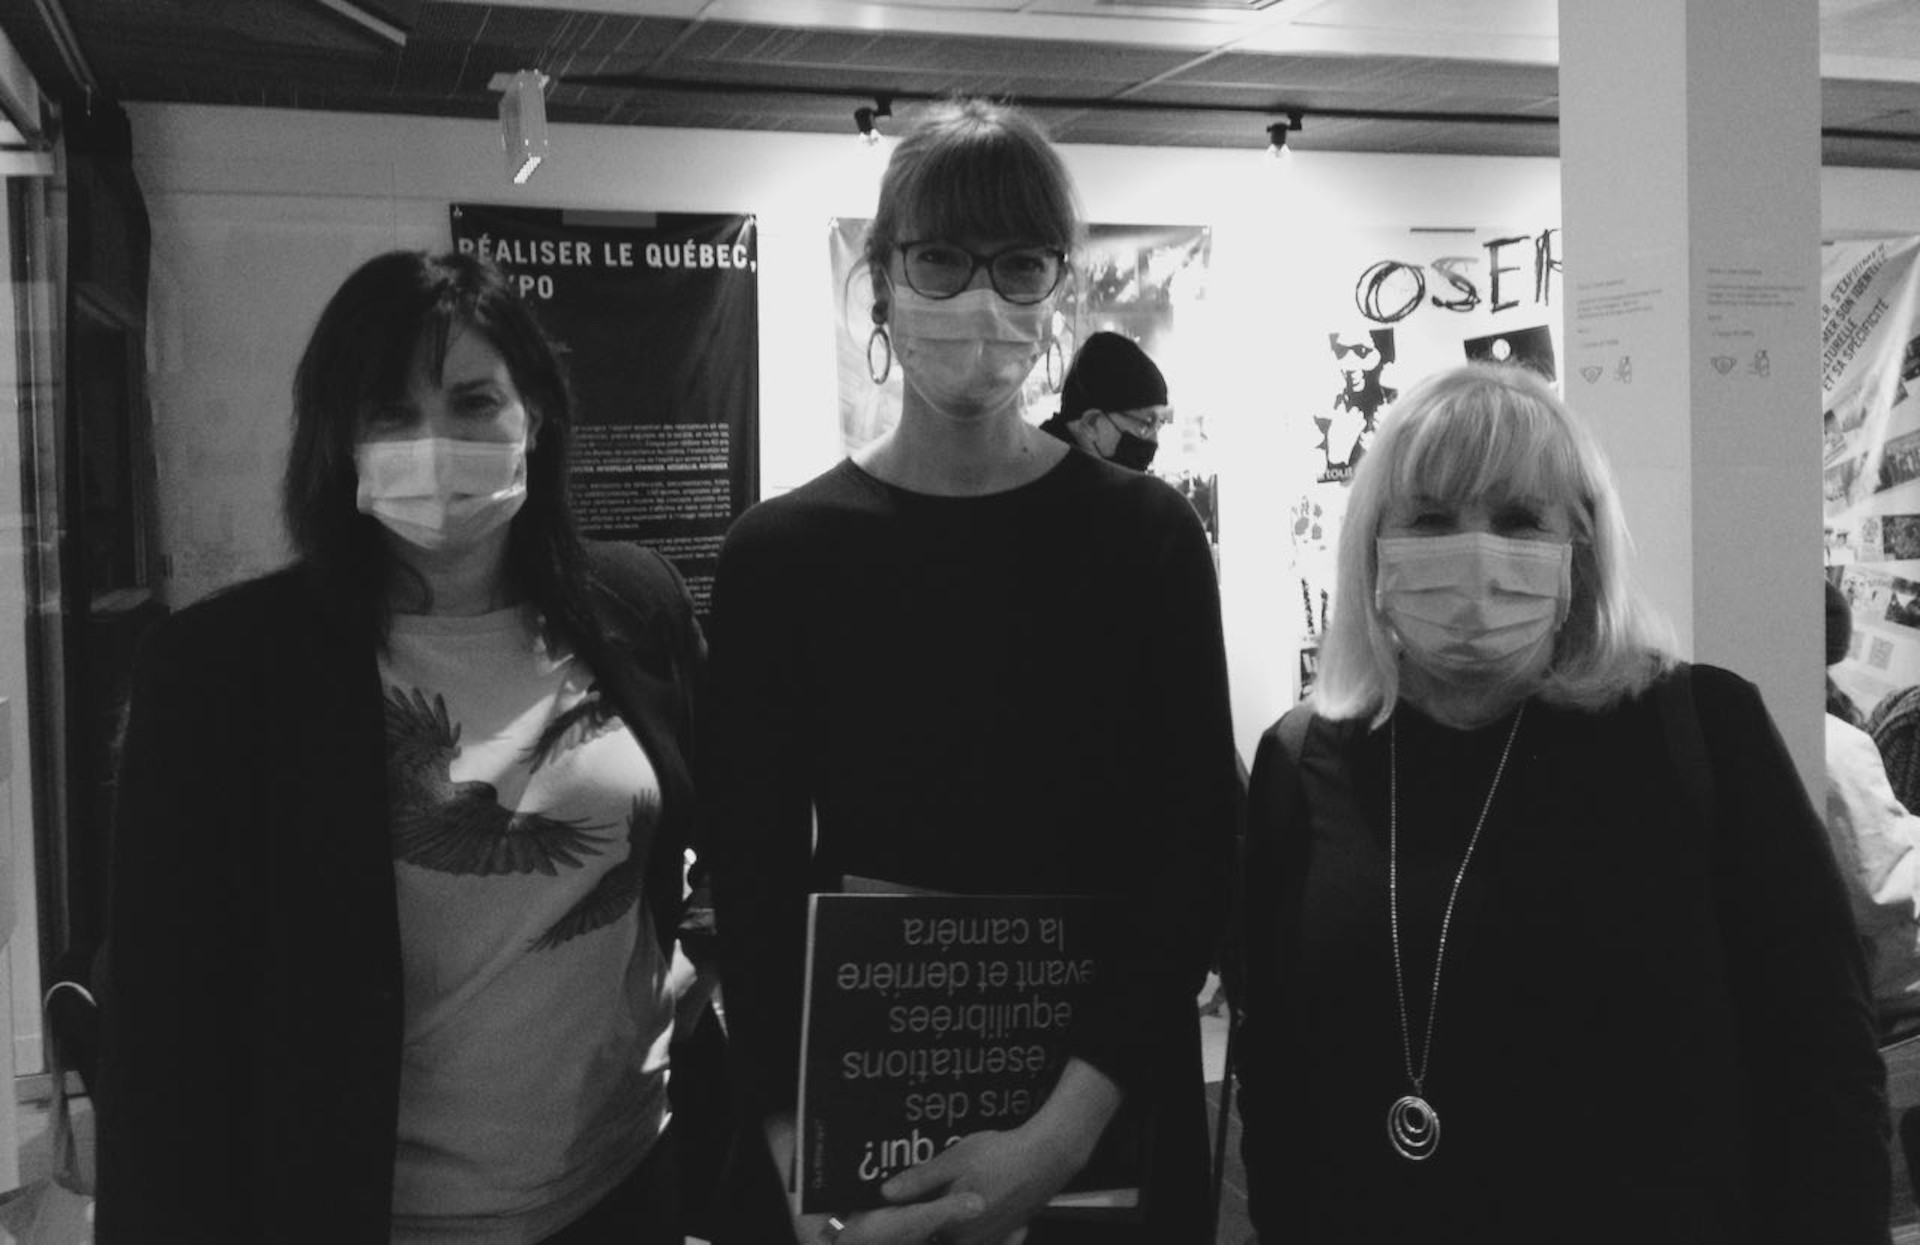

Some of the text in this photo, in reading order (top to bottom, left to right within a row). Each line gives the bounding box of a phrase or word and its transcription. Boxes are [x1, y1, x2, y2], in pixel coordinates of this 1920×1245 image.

[458, 233, 757, 273] RÉALISER LE QUÉBEC,
[1832, 360, 1846, 377] SA
[904, 917, 1064, 952] la caméra
[838, 960, 1095, 996] evant et derrière
[905, 1089, 1030, 1127] ers des
[858, 1129, 935, 1180] qui?
